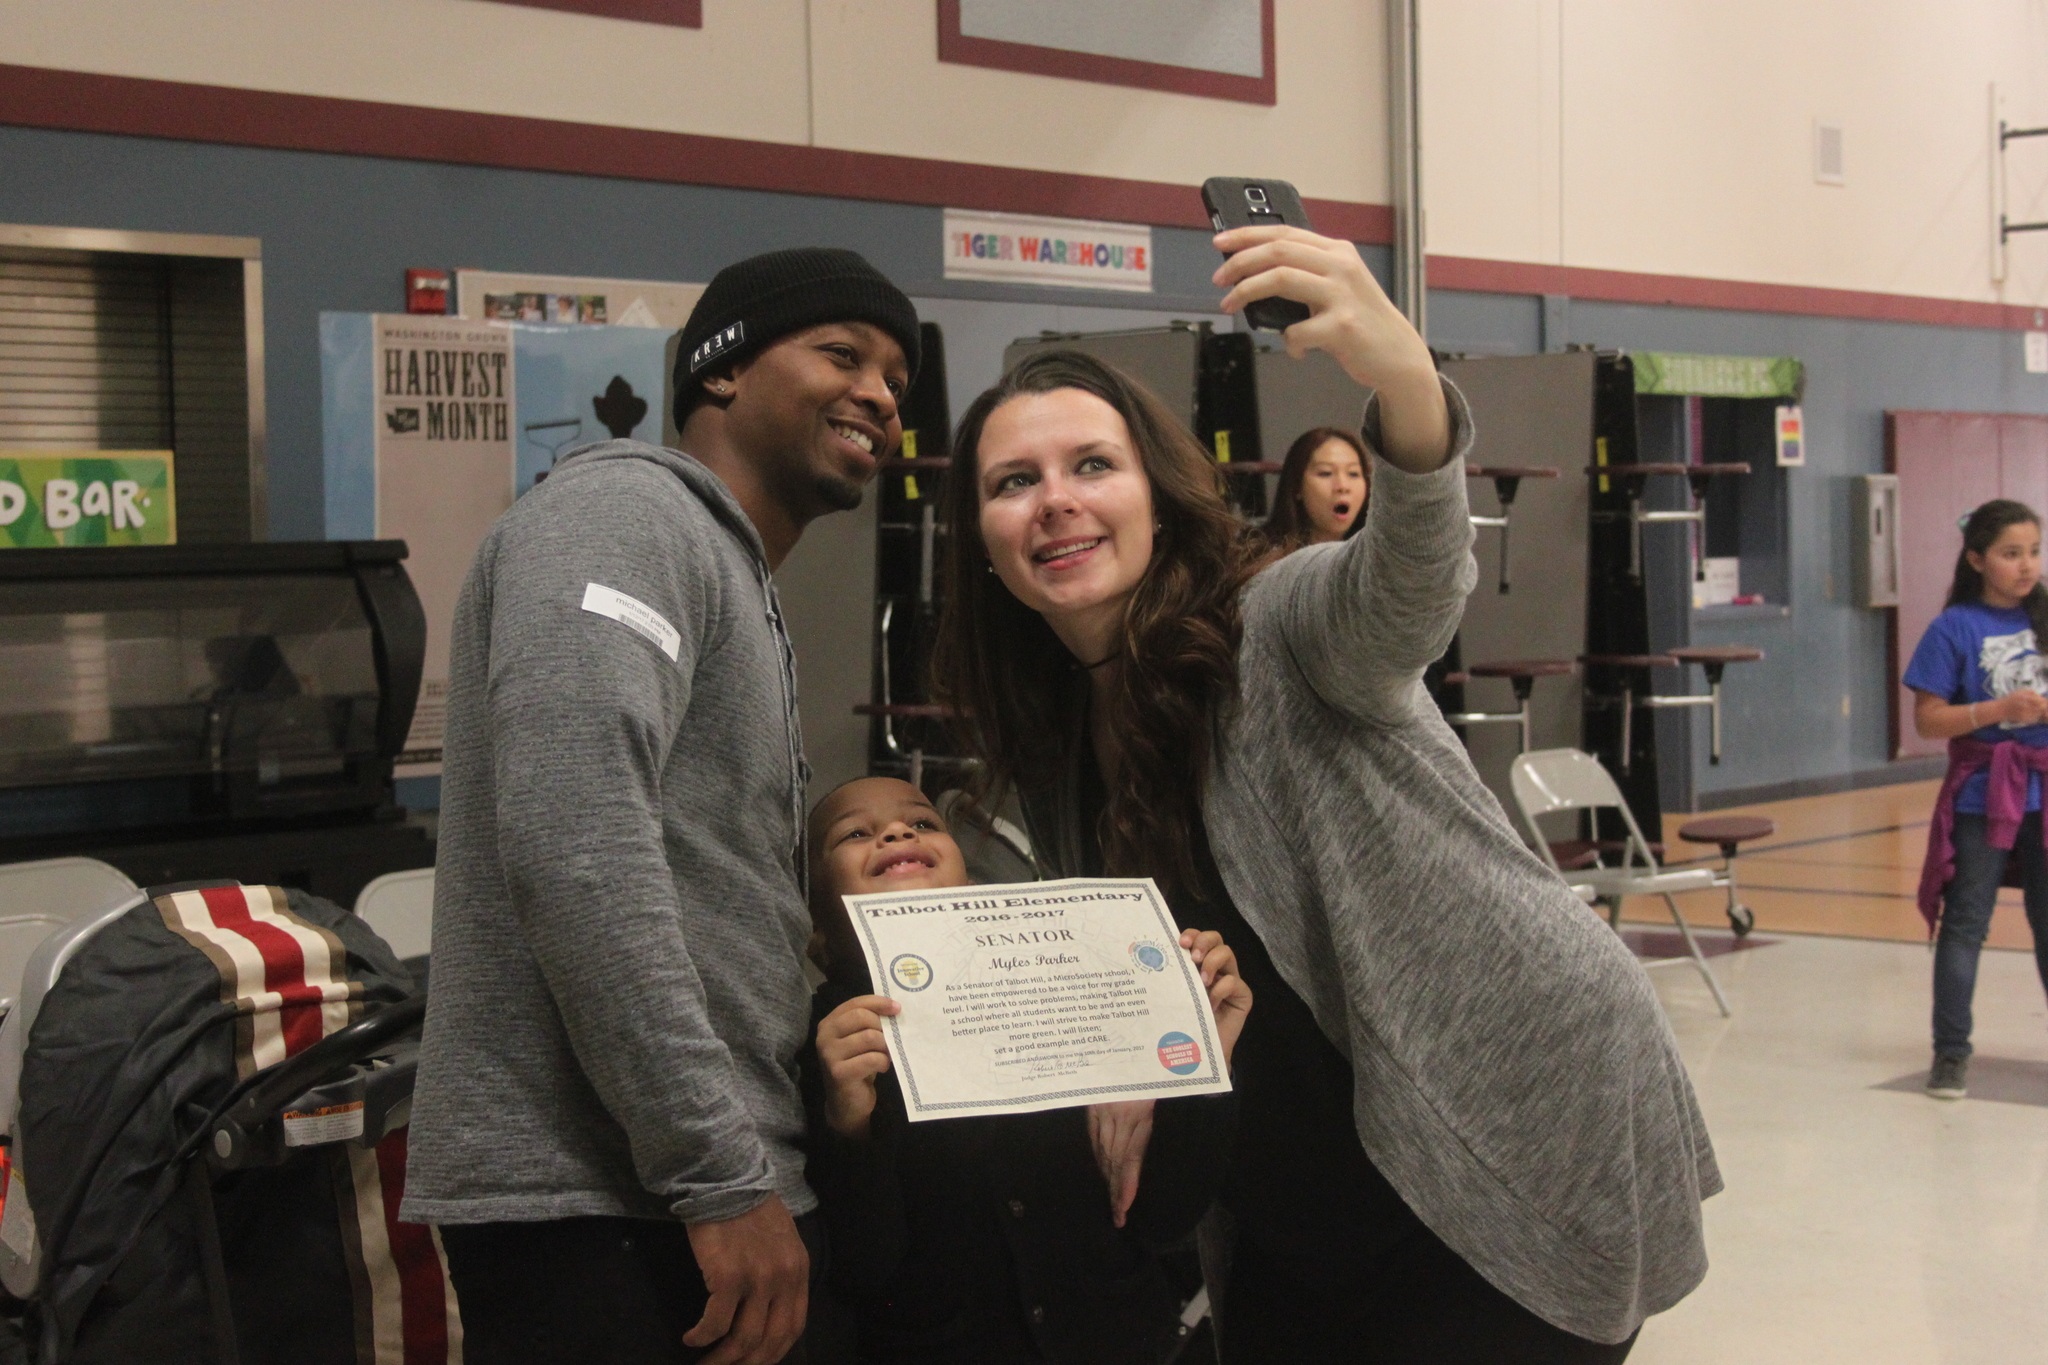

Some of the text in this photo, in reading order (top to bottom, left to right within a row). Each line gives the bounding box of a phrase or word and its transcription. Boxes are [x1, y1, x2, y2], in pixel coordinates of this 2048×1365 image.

[952, 232, 1146, 271] TIGER WAREHOUSE
[384, 330, 506, 342] WASHINGTON GROWN
[384, 349, 506, 398] HARVEST
[426, 402, 508, 442] MONTH
[616, 597, 650, 618] michael
[650, 616, 673, 638] parker
[866, 892, 1143, 918] Talbot Hill Elementary
[964, 910, 1064, 923] 2016-2017
[976, 929, 1075, 948] SENATOR
[988, 953, 1080, 972] Myles Parker
[948, 994, 968, 1002] have
[991, 987, 1037, 998] empowered
[1066, 983, 1086, 991] voice
[1100, 981, 1112, 989] my
[1114, 979, 1135, 988] grade
[963, 981, 993, 990] Senator
[1004, 978, 1029, 986] Talbot
[1030, 976, 1046, 984] Hill,
[1054, 972, 1102, 982] MicroSociety
[1104, 969, 1131, 977] school,
[942, 1005, 964, 1014] level.
[970, 1003, 985, 1011] will
[987, 1001, 1006, 1009] work
[1018, 998, 1038, 1006] solve
[1040, 994, 1079, 1005] problems,
[1080, 991, 1108, 1000] making
[1109, 989, 1133, 998] Talbot
[1134, 987, 1147, 995] Hill
[952, 1028, 977, 1037] better
[978, 1025, 1000, 1034] place
[1040, 1018, 1055, 1026] will
[1056, 1016, 1077, 1024] strive
[1089, 1013, 1110, 1021] make
[1111, 1010, 1135, 1019] Talbot
[1136, 1008, 1150, 1016] Hill
[958, 1014, 983, 1024] school
[985, 1012, 1010, 1021] where
[1011, 1010, 1021, 1018] all
[1022, 1007, 1056, 1016] students
[1057, 1005, 1076, 1013] want
[1100, 1001, 1114, 1009] and
[1032, 1031, 1056, 1039] green.
[1062, 1027, 1076, 1035] will
[994, 1047, 1006, 1055] set
[1015, 1042, 1035, 1053] good
[1036, 1039, 1069, 1049] example
[1071, 1037, 1086, 1045] and
[1087, 1035, 1110, 1043] CARE.
[994, 1058, 1026, 1067] SUBSCRIBED
[1170, 1057, 1193, 1066] AMERICA
